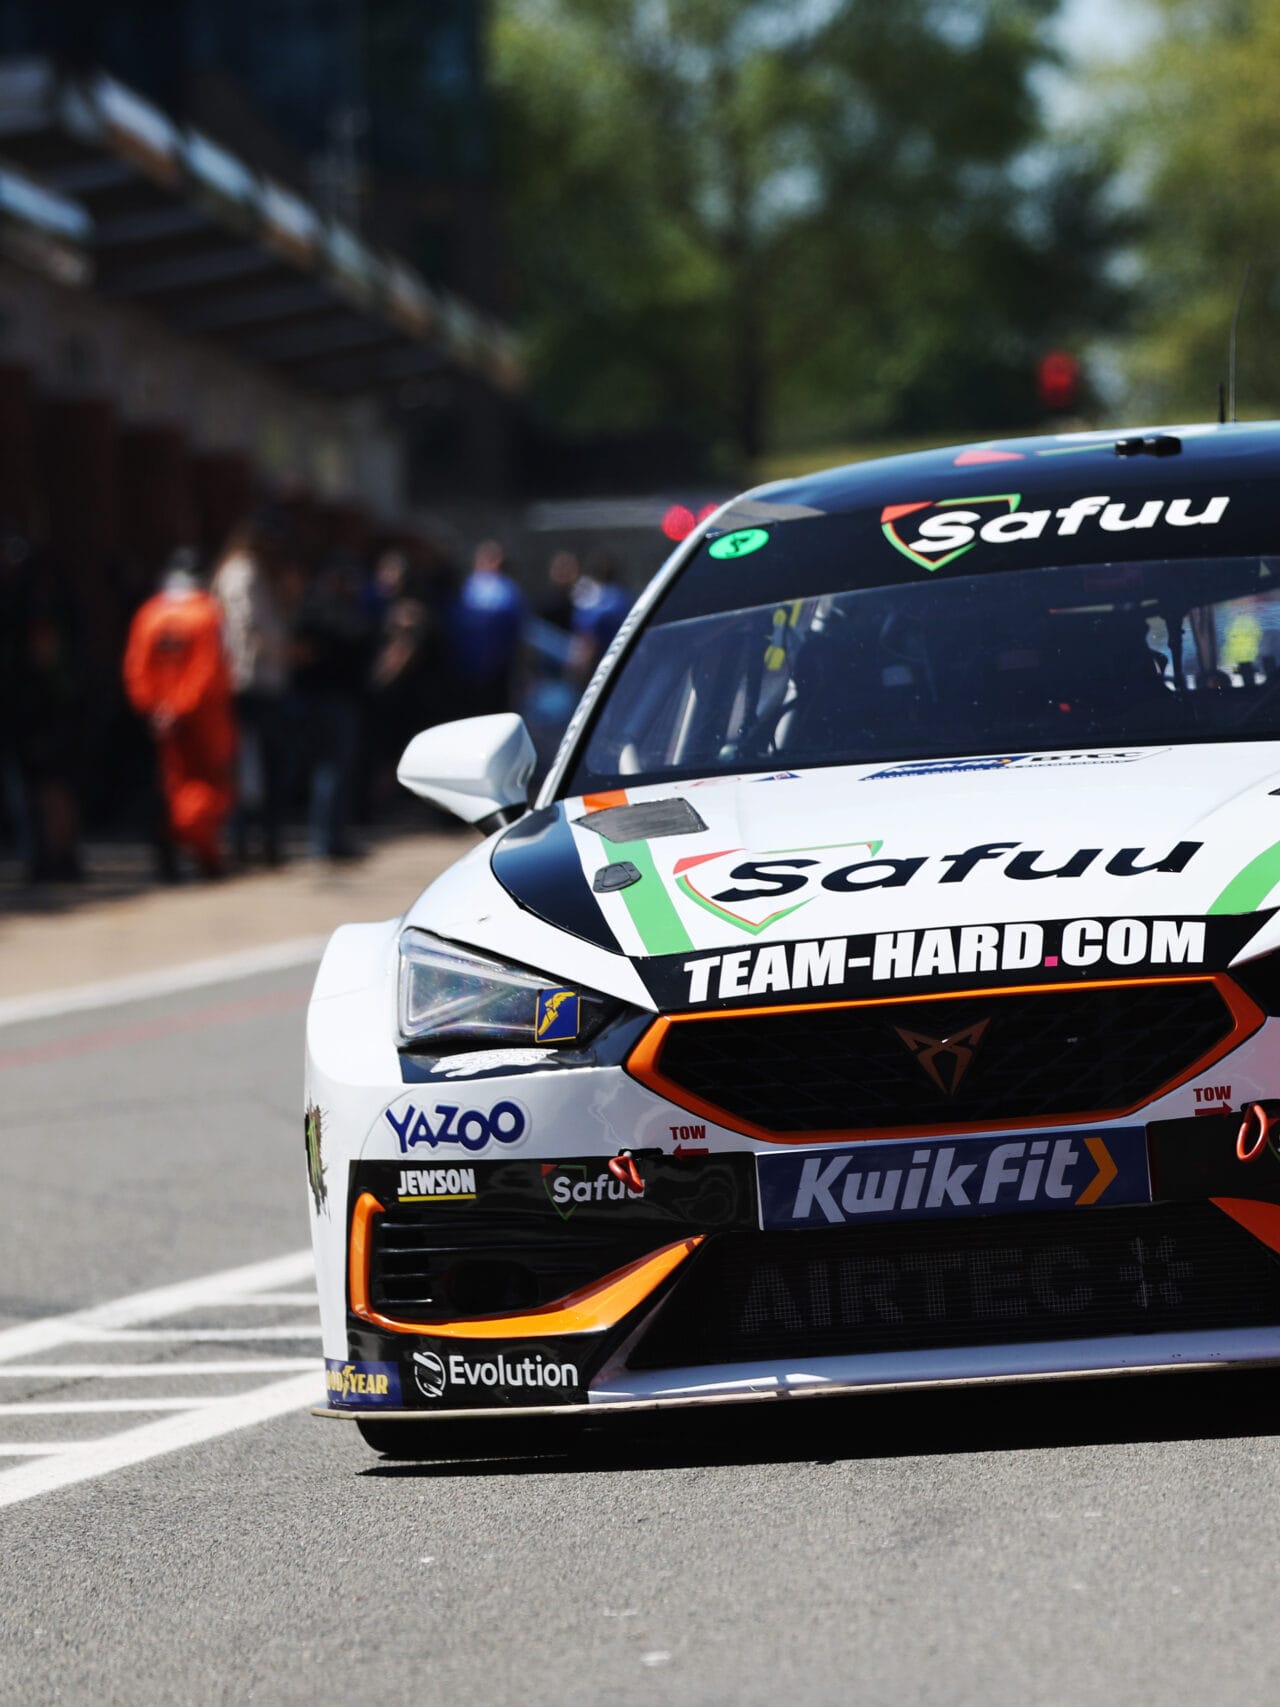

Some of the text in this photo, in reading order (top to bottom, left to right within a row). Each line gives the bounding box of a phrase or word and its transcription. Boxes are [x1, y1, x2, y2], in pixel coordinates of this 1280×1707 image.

[908, 496, 1230, 553] Safuu
[710, 841, 1205, 902] Safuu
[683, 918, 1207, 1003] TEAM-HARD.COM
[1193, 1085, 1232, 1103] TOW
[384, 1100, 526, 1154] YAZOO
[669, 1125, 707, 1140] TOW
[397, 1168, 476, 1196] JEWSON
[737, 1245, 1096, 1334] AIRTEC
[450, 1354, 578, 1388] Evolution
